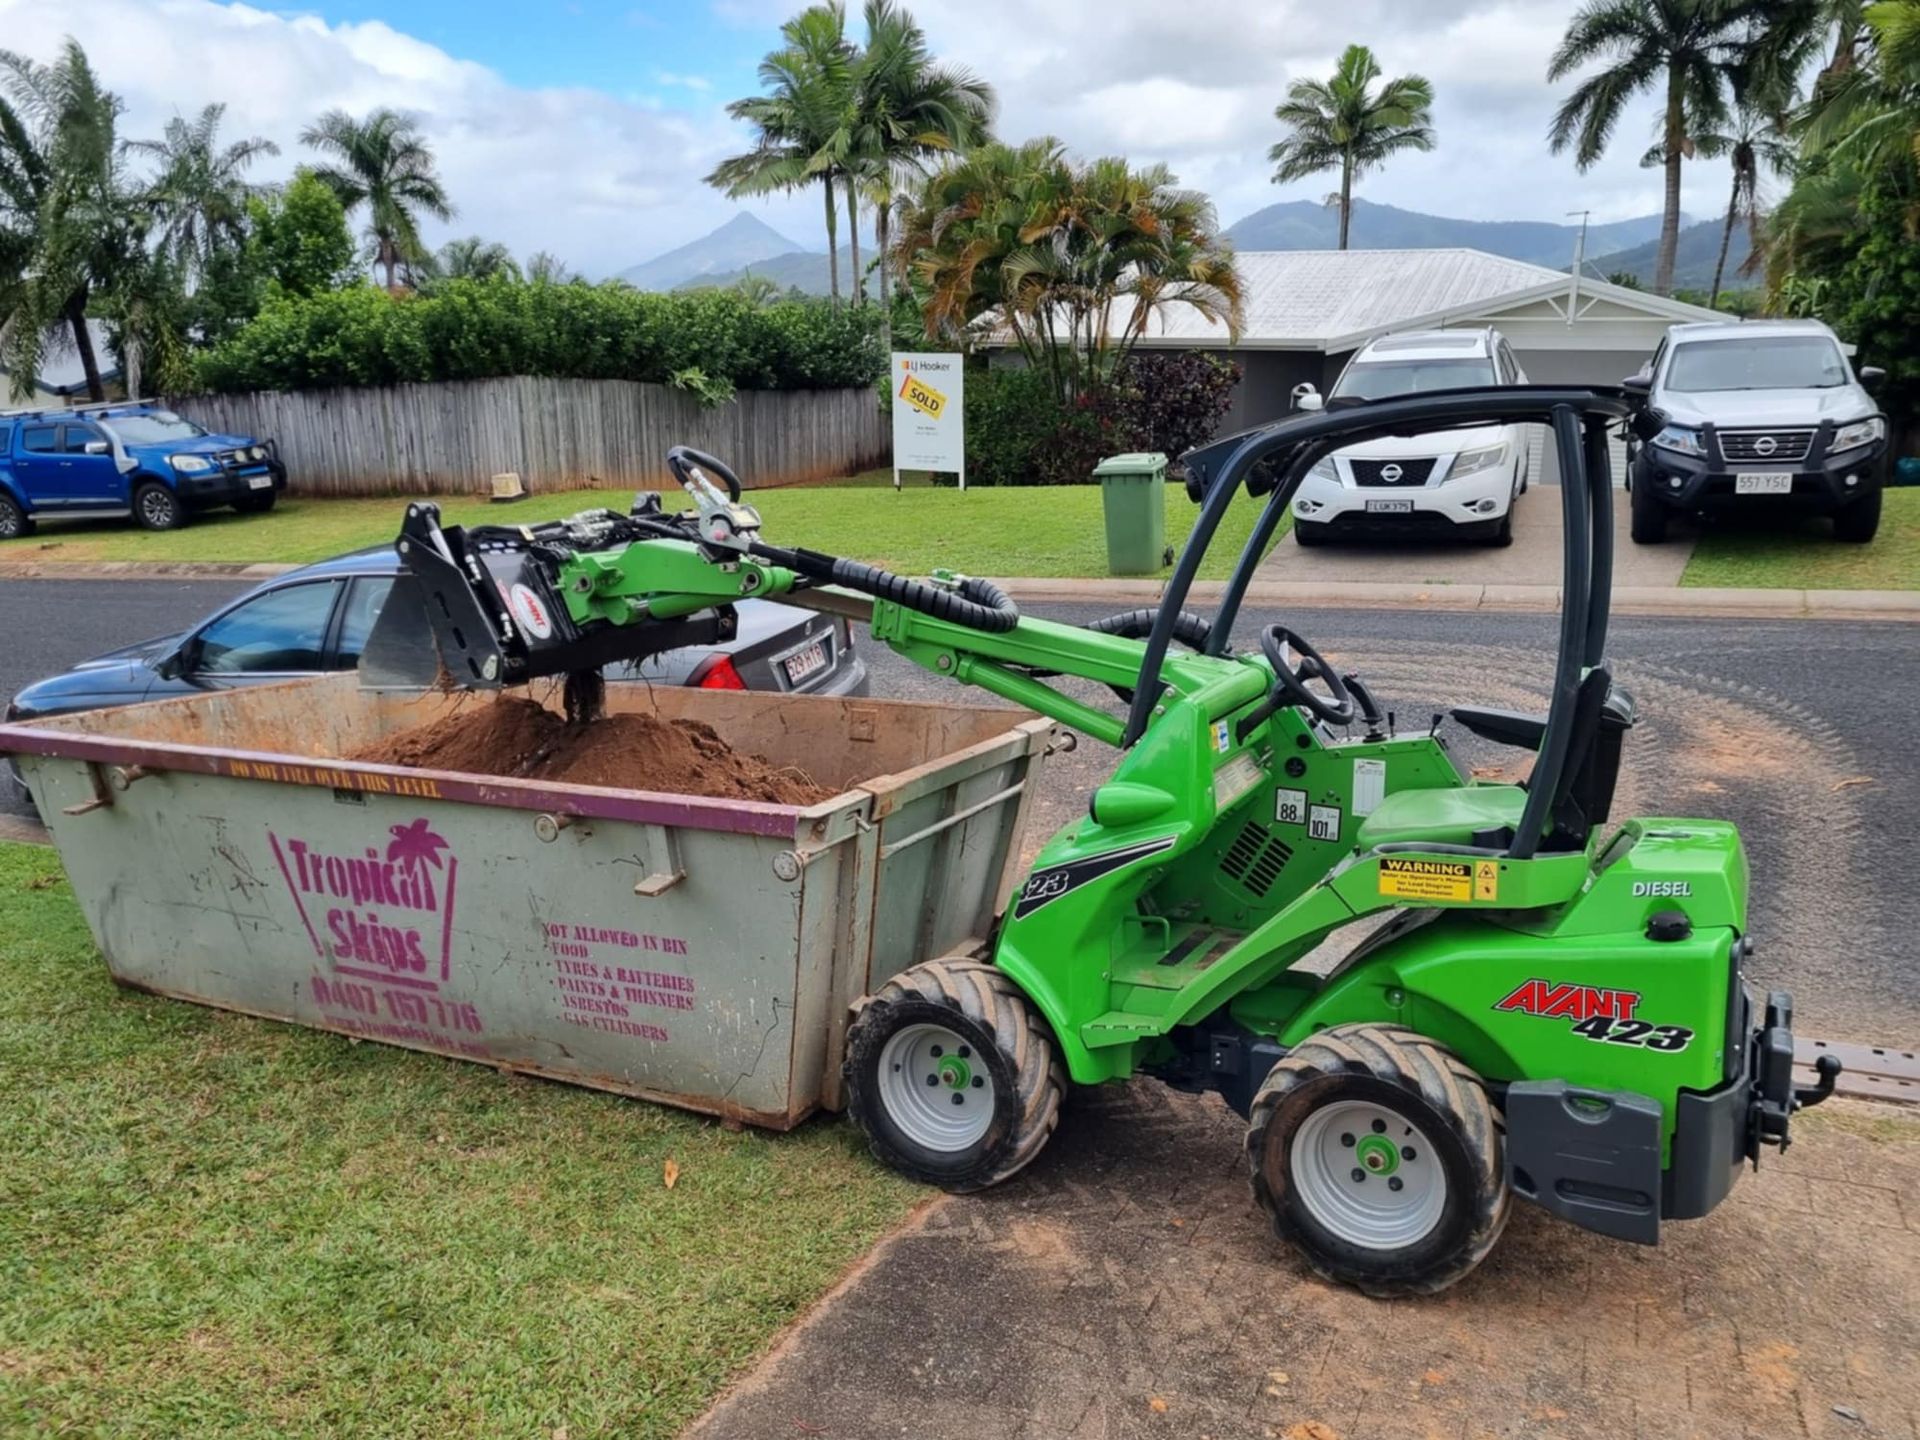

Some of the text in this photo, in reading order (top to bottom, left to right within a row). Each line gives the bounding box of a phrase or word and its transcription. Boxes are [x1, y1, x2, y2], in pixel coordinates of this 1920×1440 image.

[920, 362, 950, 371] Hooker
[909, 387, 940, 412] SOLD
[253, 763, 279, 781] NOT
[315, 768, 353, 789] OVER
[357, 773, 391, 792] THIS
[395, 777, 442, 798] LEVEL
[1281, 803, 1297, 820] 88
[1312, 820, 1329, 838] 101
[1386, 860, 1465, 875] WARNING
[1020, 871, 1069, 902] 23
[1632, 881, 1692, 897] DIESEL
[327, 908, 428, 973] Skips
[542, 922, 688, 955] NOT ALLOWED IN BIN
[552, 942, 589, 958] FOOD
[554, 960, 695, 992] TYRES & BATTERIES
[558, 977, 694, 1011] PAINTS & THINNERS
[562, 995, 629, 1018] ASBESTOS
[1492, 978, 1642, 1022] AVANT
[429, 994, 483, 1033] 776
[564, 1012, 669, 1041] GAS CYLINDERS
[1571, 1015, 1695, 1053] 423
